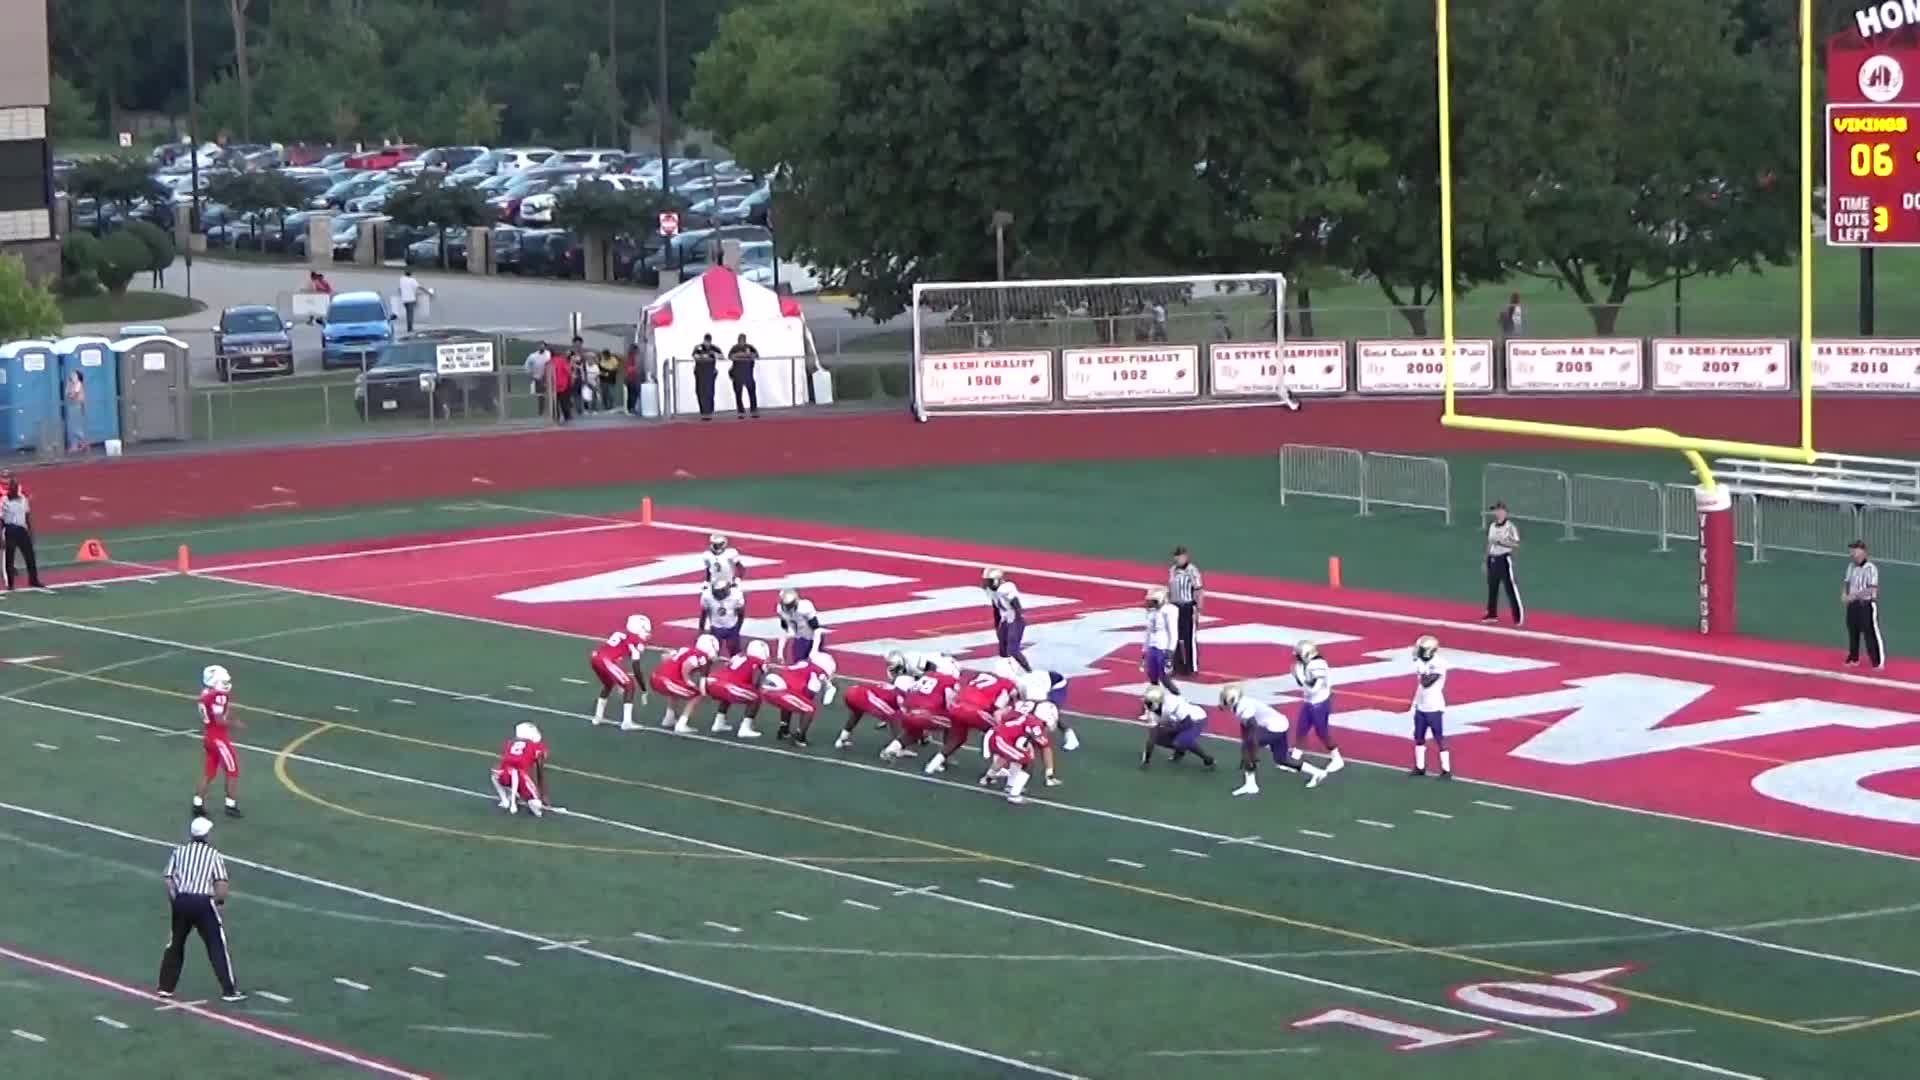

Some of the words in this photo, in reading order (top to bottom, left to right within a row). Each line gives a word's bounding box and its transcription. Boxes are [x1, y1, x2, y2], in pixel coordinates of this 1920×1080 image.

[1834, 117, 1908, 132] VIKINGS
[1851, 144, 1893, 176] 06
[1839, 197, 1870, 210] TIME
[1835, 213, 1870, 226] OUTS
[1874, 207, 1888, 232] 3
[1838, 228, 1869, 241] LEFT
[1407, 362, 1443, 374] 2000
[1556, 361, 1592, 373] 2005
[1702, 361, 1739, 373] 2007
[1850, 361, 1888, 373] 2010
[1699, 513, 1709, 634] VIKINGS
[1290, 963, 1640, 1052] 10
